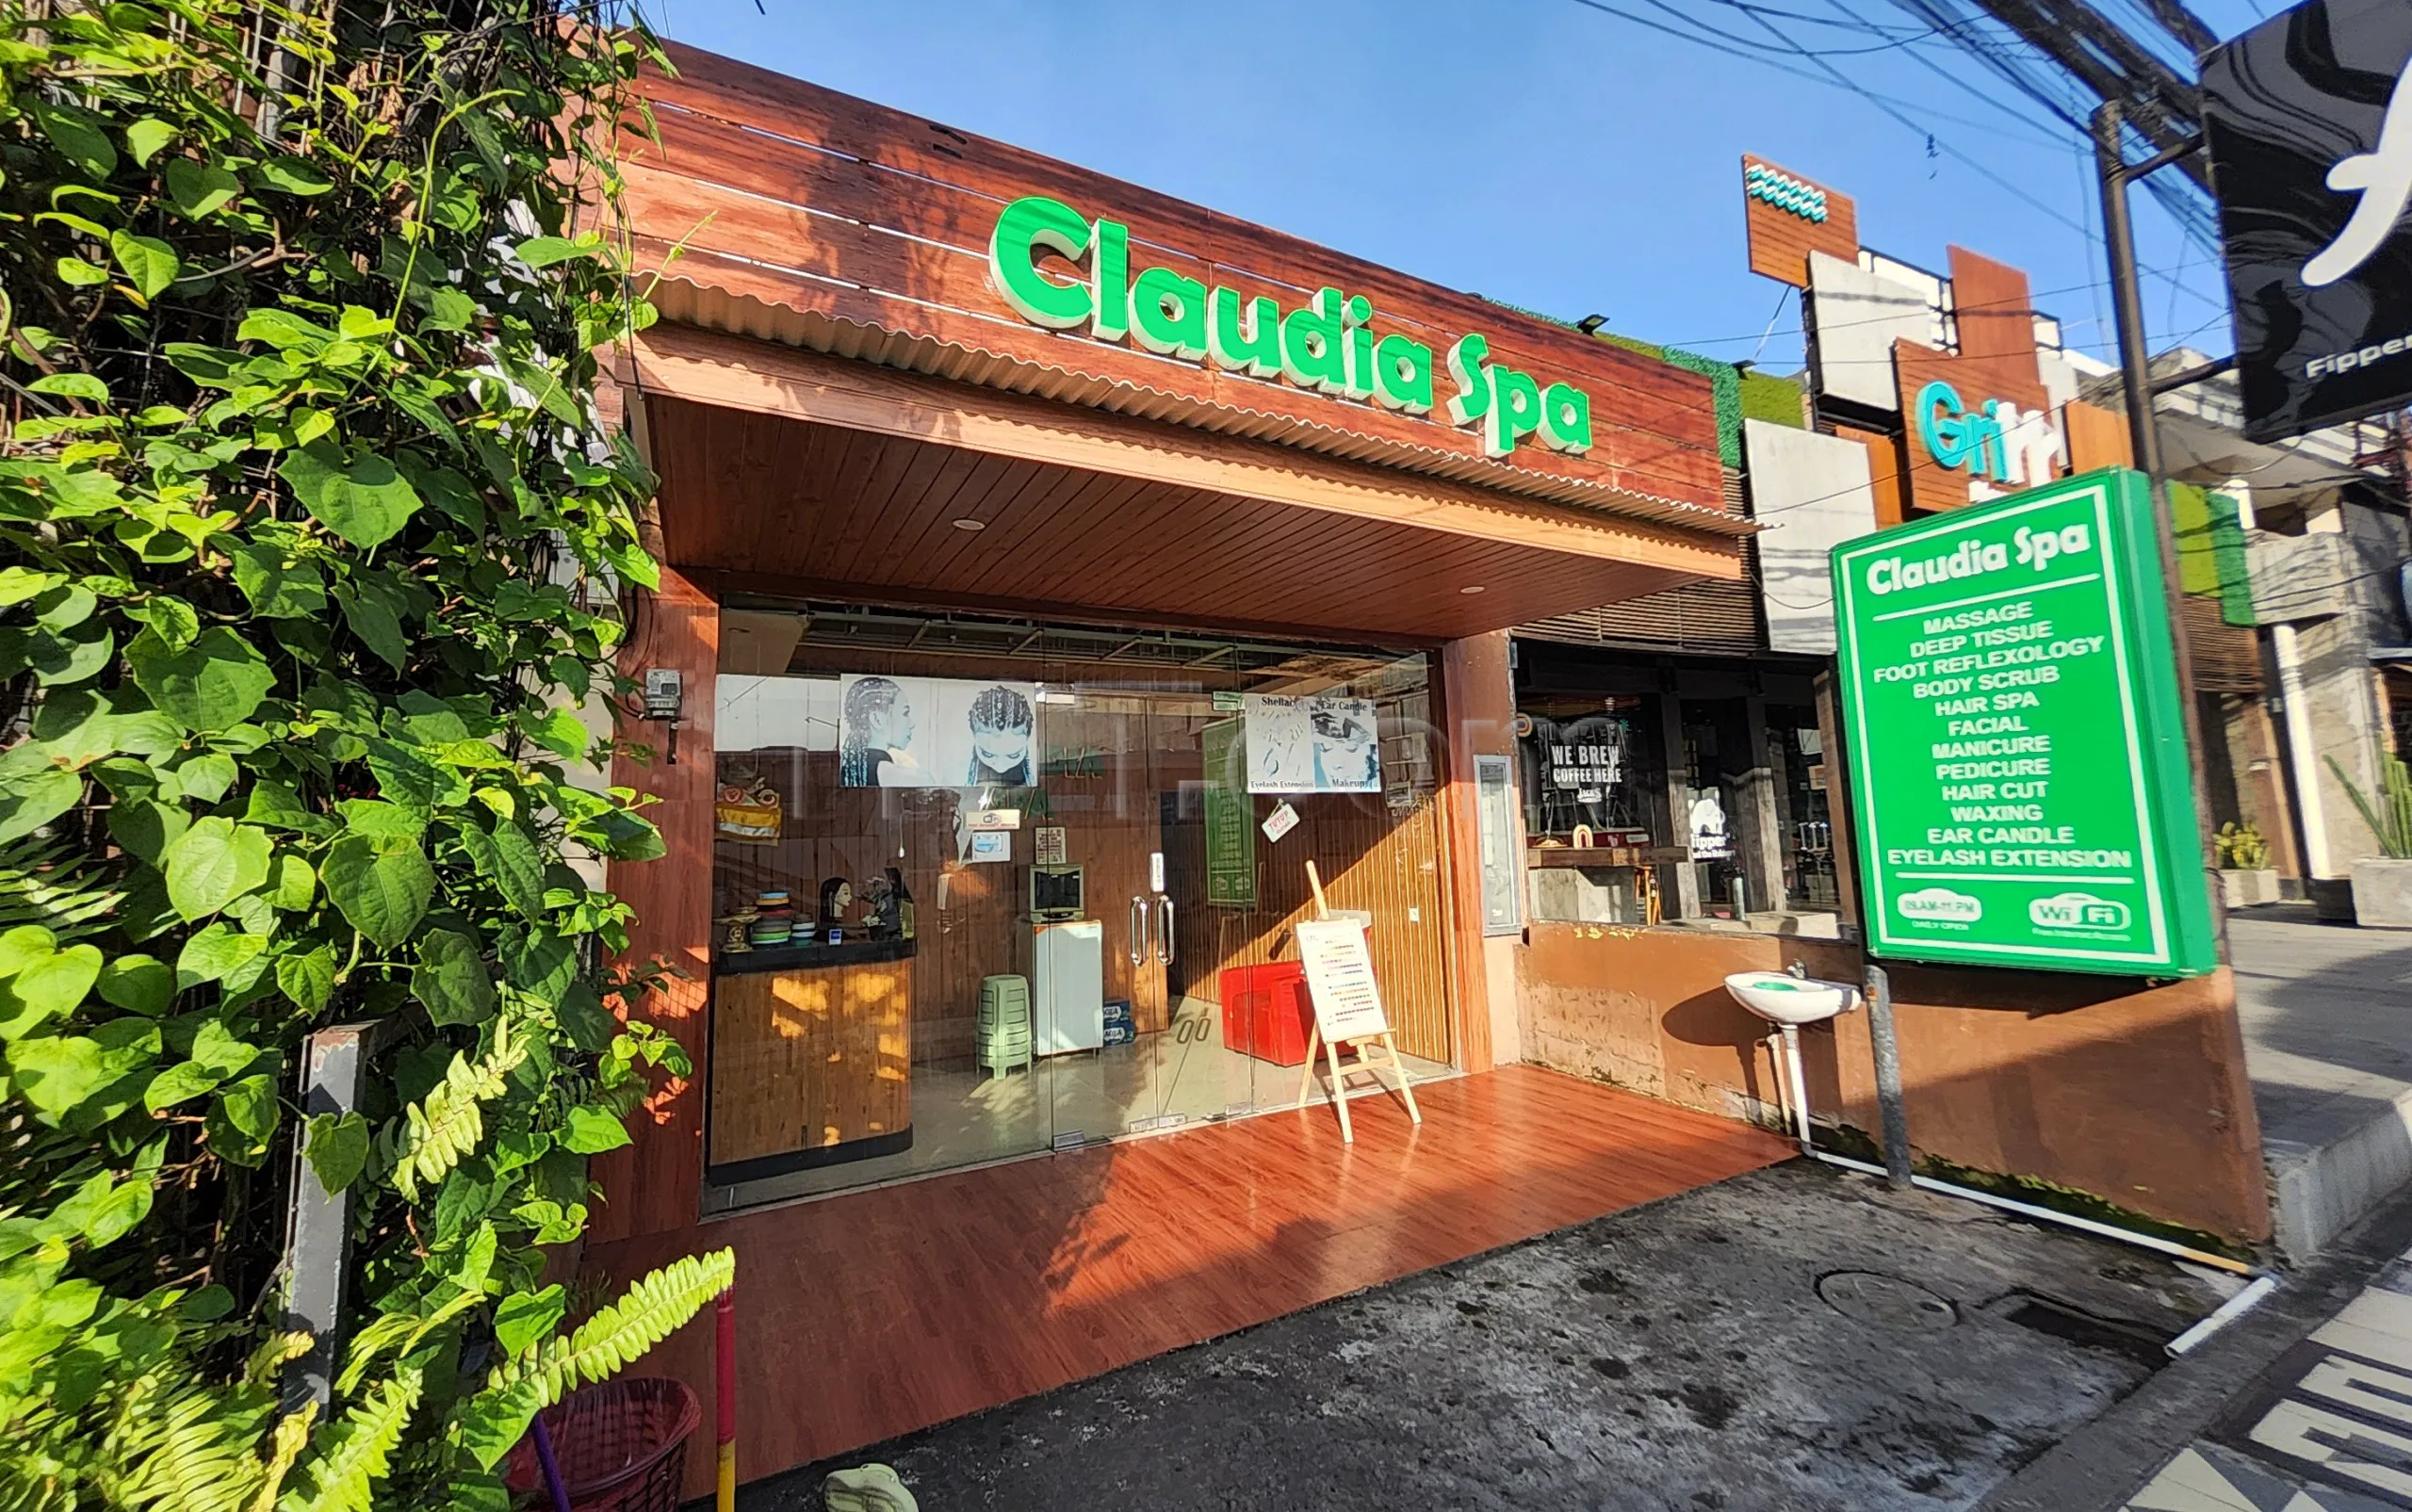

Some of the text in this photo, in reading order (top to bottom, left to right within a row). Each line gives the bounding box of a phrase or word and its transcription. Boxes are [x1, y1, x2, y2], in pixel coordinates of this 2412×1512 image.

[989, 195, 1593, 458] Claudia Spa
[1866, 523, 2091, 595] Claudia Spa
[1923, 601, 2033, 635] MASSAGE
[1909, 620, 2053, 658] DEEP TISSUE
[1873, 635, 2106, 684] FOOT REFLEXOLOGY
[1913, 665, 2061, 699] BODY SCRUB
[1934, 691, 2040, 717] HAIR SPA
[1948, 714, 2029, 737] FACIAL
[1551, 745, 1620, 766] WE BREW
[1931, 736, 2052, 760] MANICURE
[1553, 768, 1622, 783] COFFEE HERE
[1936, 757, 2052, 780] PEDICURE
[1941, 780, 2049, 802] HAIR CUT
[1268, 810, 1289, 832] TUTUP
[1950, 804, 2043, 822] WAXING
[1927, 826, 2076, 845] EAR CANDLE
[1887, 849, 2133, 870] EYELASH EXTENSION
